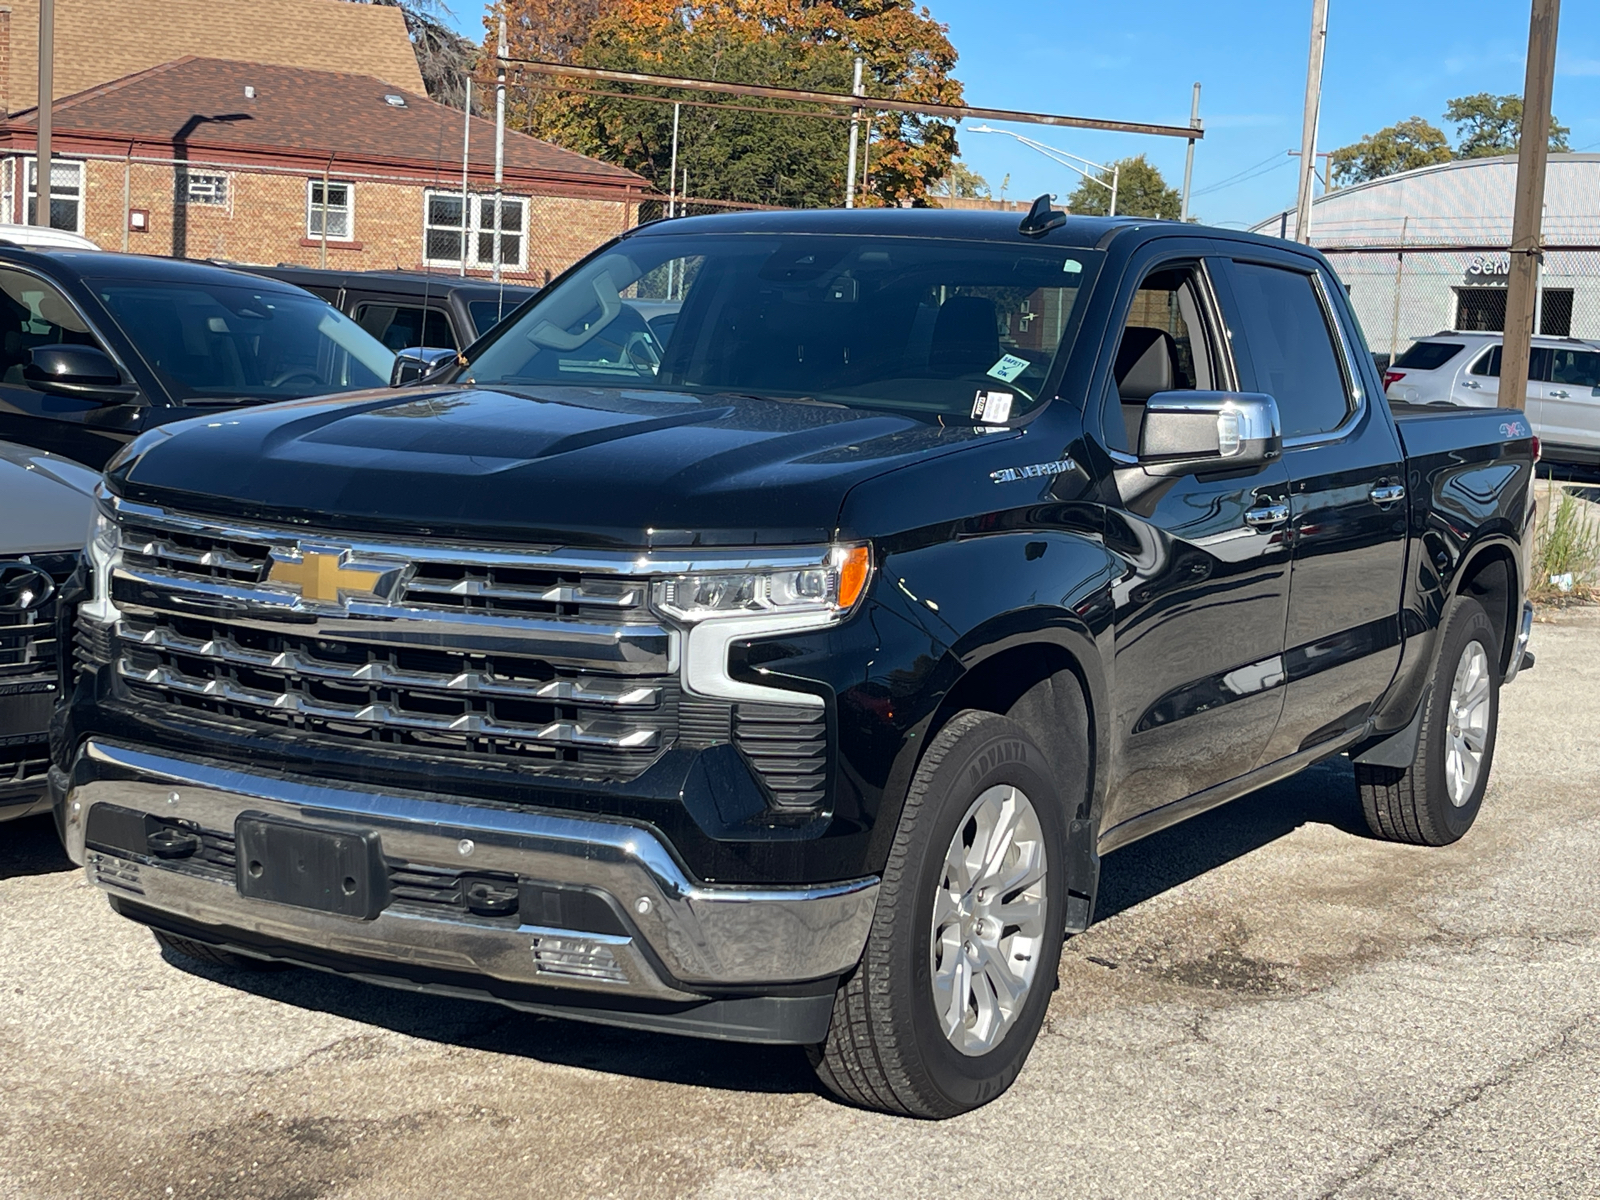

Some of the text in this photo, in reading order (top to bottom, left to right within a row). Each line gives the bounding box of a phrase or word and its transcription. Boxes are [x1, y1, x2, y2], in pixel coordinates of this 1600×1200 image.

[1469, 256, 1510, 275] Serv
[1002, 356, 1025, 368] SAFETY
[997, 369, 1008, 377] OK
[0, 686, 18, 694] OUTH
[968, 741, 1028, 785] ADVANTA
